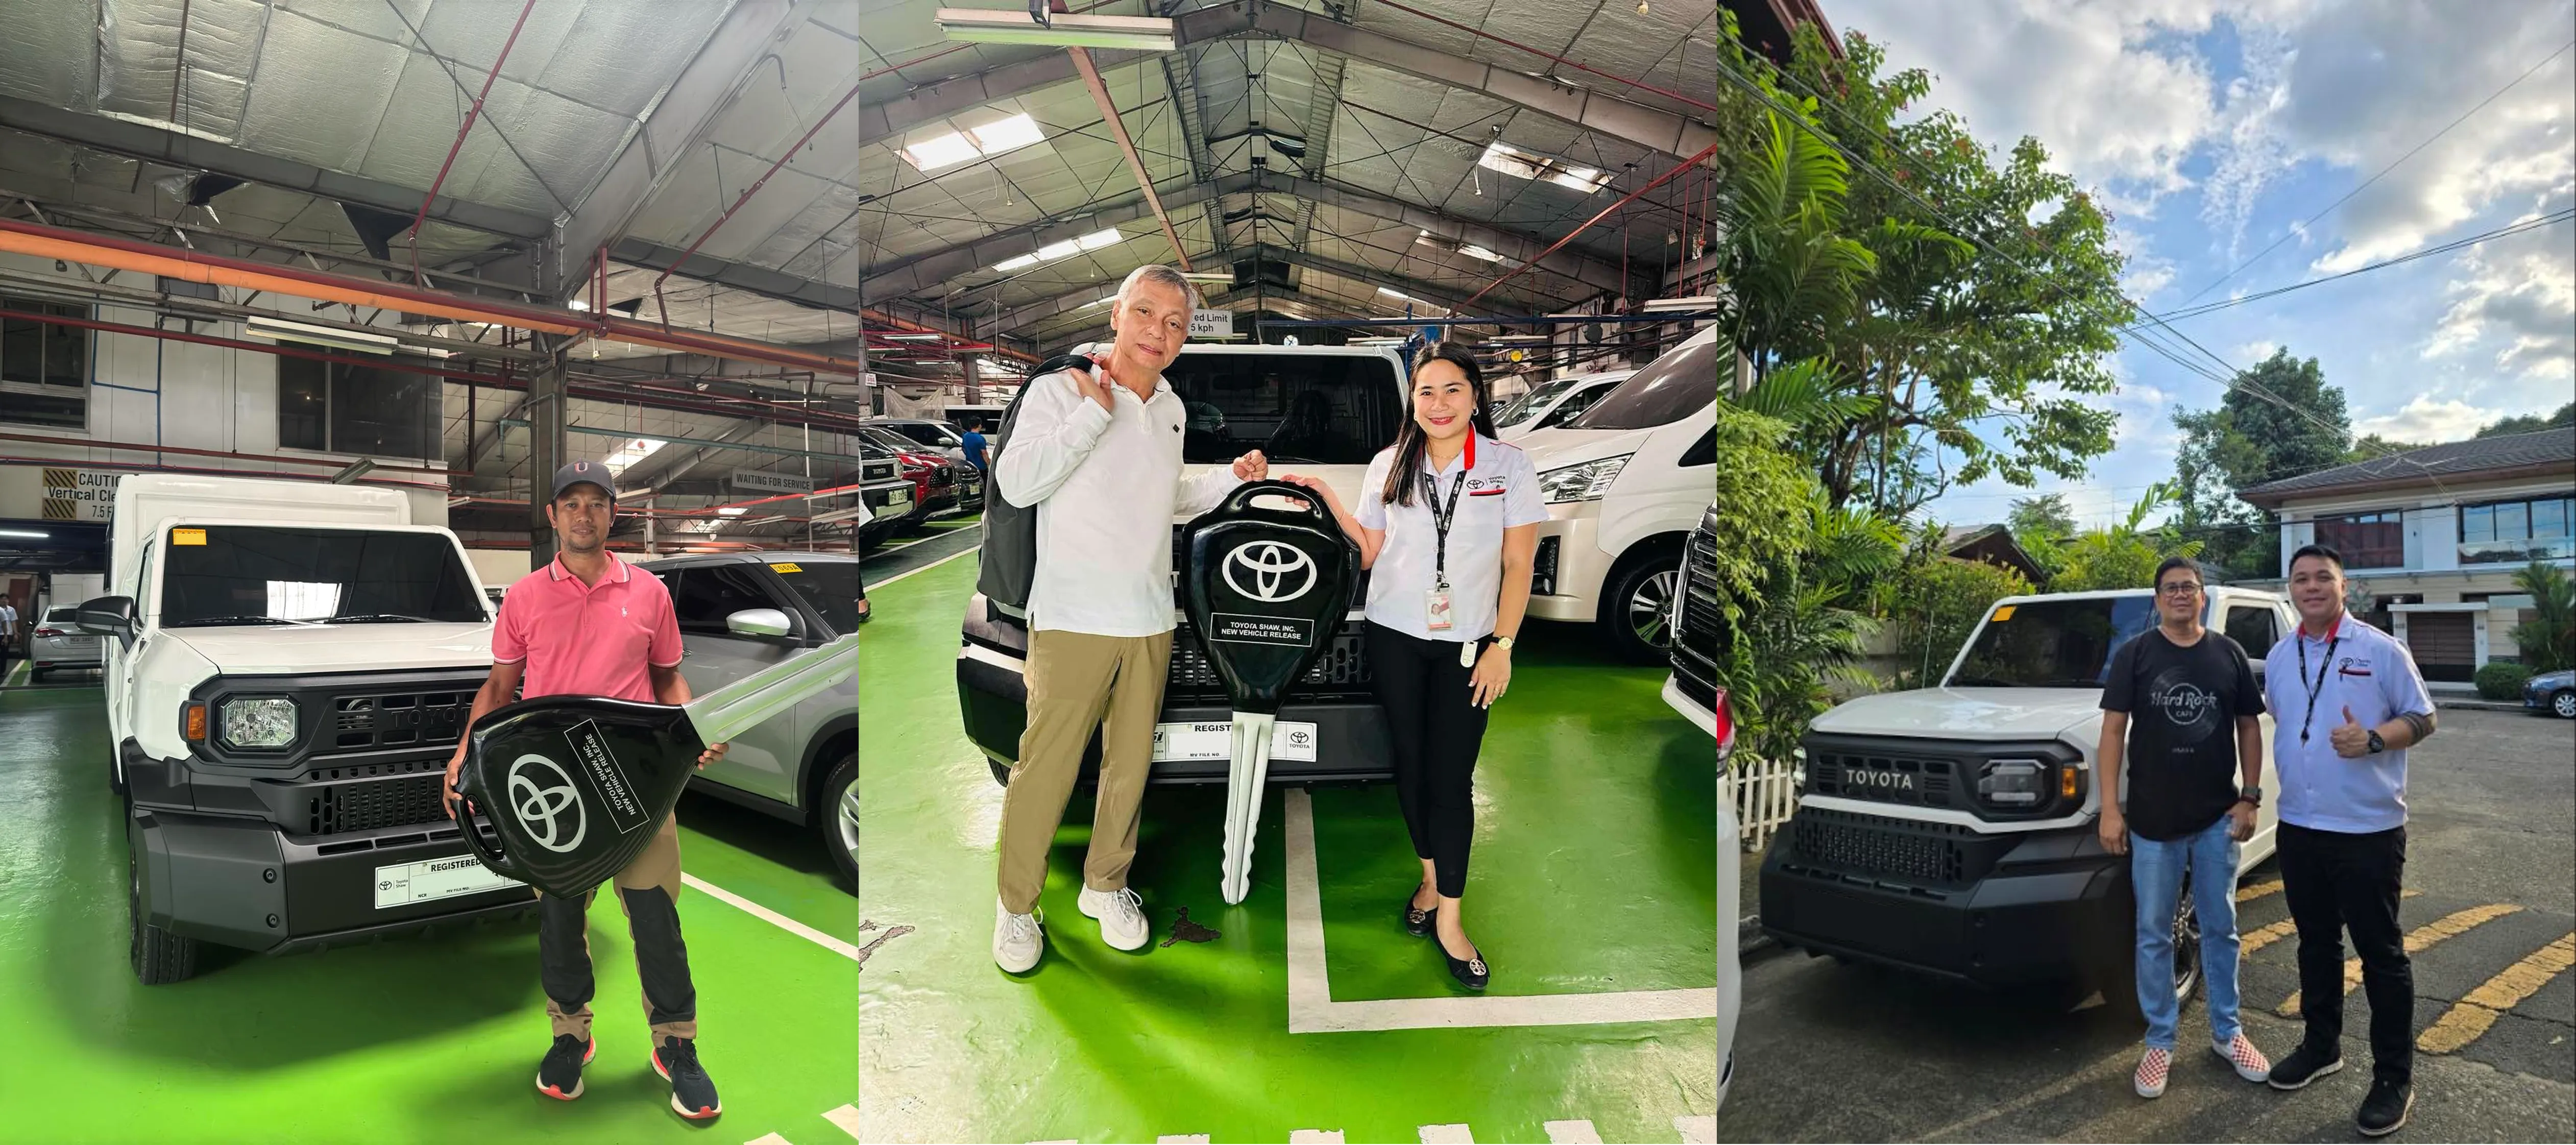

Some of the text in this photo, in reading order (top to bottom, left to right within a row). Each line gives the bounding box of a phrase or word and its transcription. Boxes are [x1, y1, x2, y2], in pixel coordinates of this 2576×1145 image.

[1207, 314, 1227, 322] Limit
[1198, 324, 1213, 333] kph
[737, 473, 810, 490] WAITING FOR SERVICE
[48, 486, 94, 501] Vertical
[92, 505, 105, 518] 7.5
[2151, 691, 2217, 710] Hard Rock
[583, 743, 593, 758] INC.
[585, 734, 636, 815] NEW VEHICLE RELEASE
[1846, 770, 1912, 789] TOYOTA
[431, 858, 481, 872] REGISTERED
